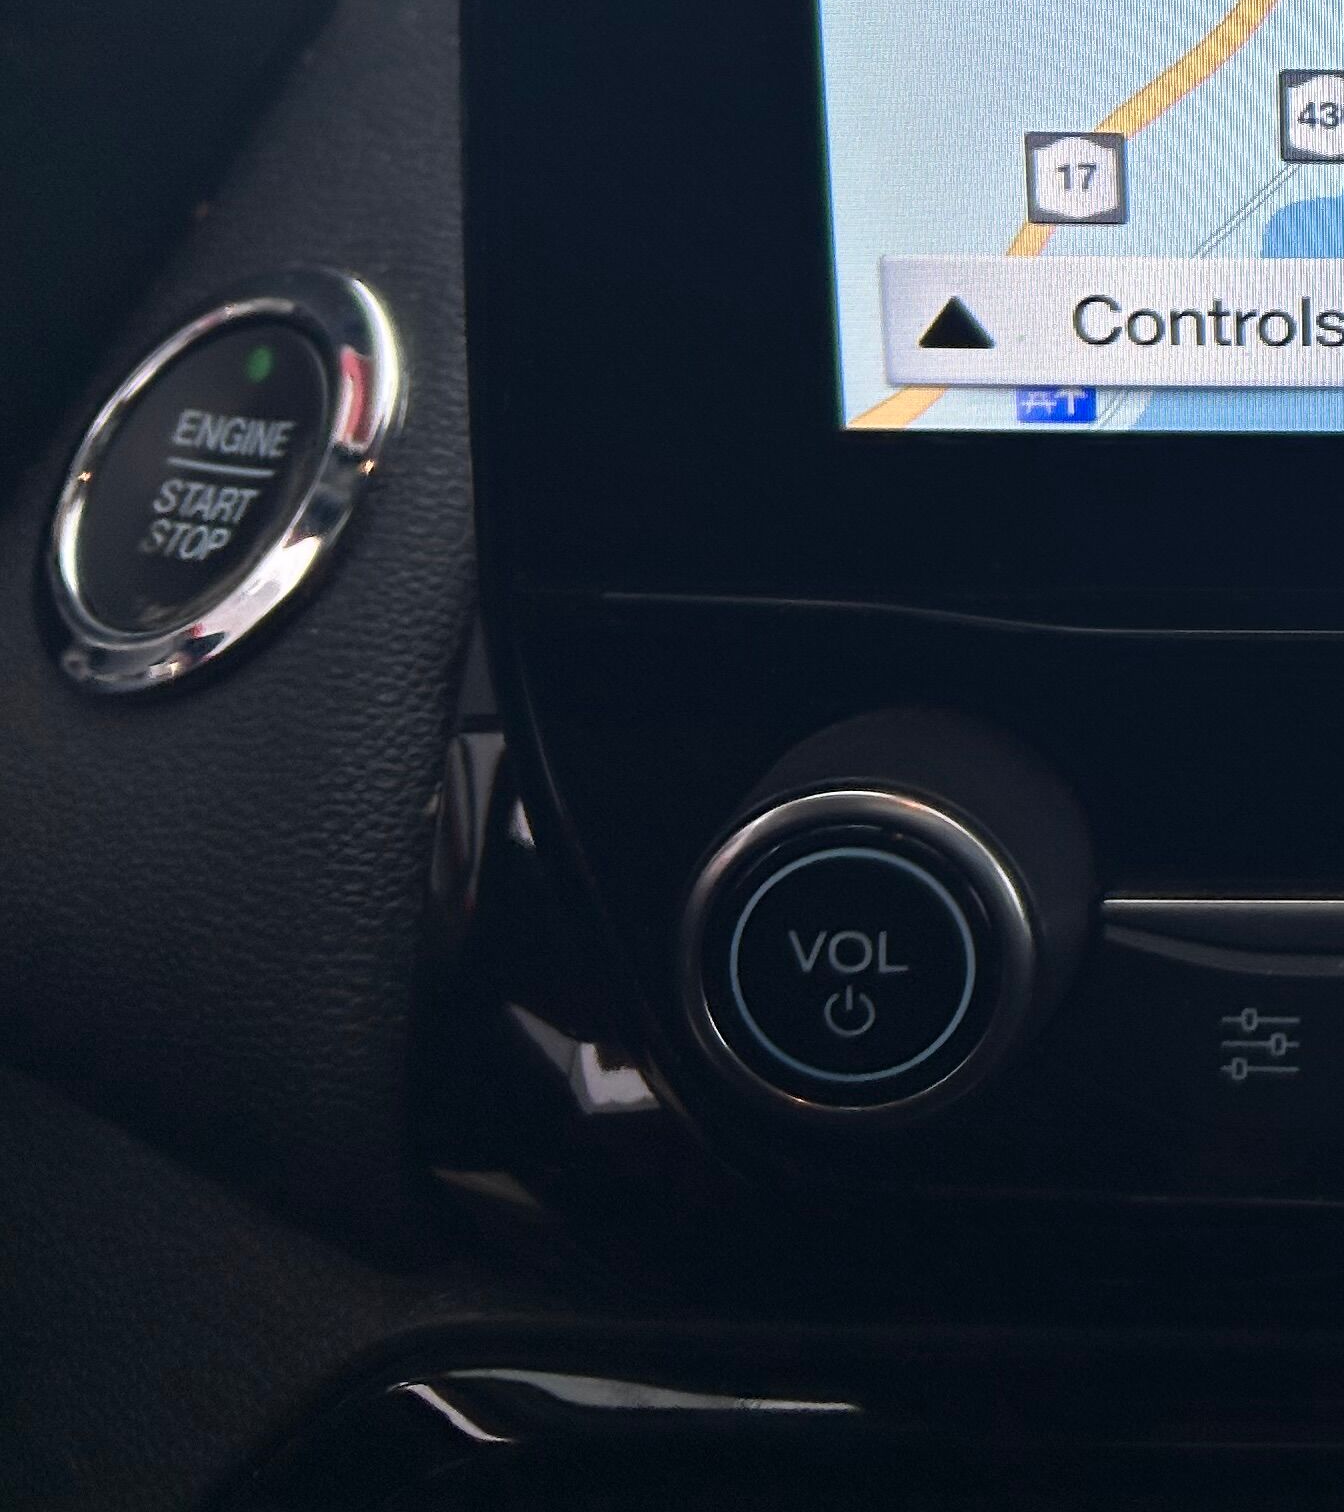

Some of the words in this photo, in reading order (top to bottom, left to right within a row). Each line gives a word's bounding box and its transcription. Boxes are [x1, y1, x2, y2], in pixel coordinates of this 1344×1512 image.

[1056, 164, 1097, 192] 17
[172, 408, 295, 459] ENGINE
[153, 478, 260, 522] START
[139, 519, 233, 561] STOP
[788, 930, 909, 974] VOL
